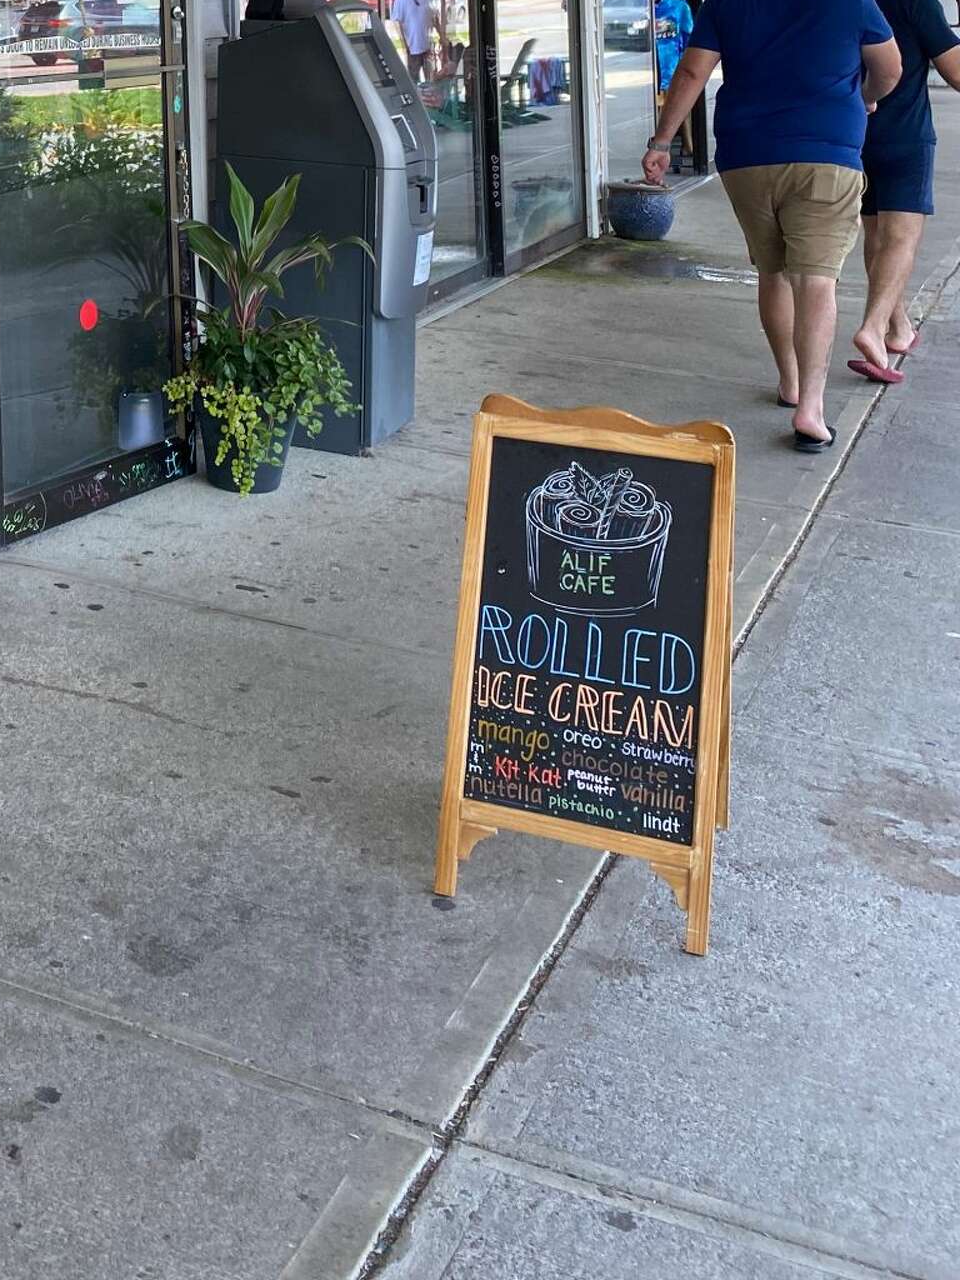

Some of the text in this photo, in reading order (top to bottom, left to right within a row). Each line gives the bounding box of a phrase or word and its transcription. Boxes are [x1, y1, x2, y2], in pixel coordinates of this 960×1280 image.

[34, 38, 59, 52] REMAIN
[114, 34, 141, 47] BUSINESS
[560, 549, 612, 574] ALIF
[560, 575, 615, 595] CAFE
[479, 605, 695, 695] ROLLED
[477, 666, 694, 749] ICE CREAM
[477, 719, 550, 761] mango
[563, 729, 603, 750] oreo
[495, 756, 520, 781] Kit
[562, 750, 668, 783] chocolate
[567, 769, 613, 786] peanut
[470, 774, 686, 812] nutella vanilla
[576, 780, 616, 797] butter
[549, 795, 681, 834] pistachio lindt
